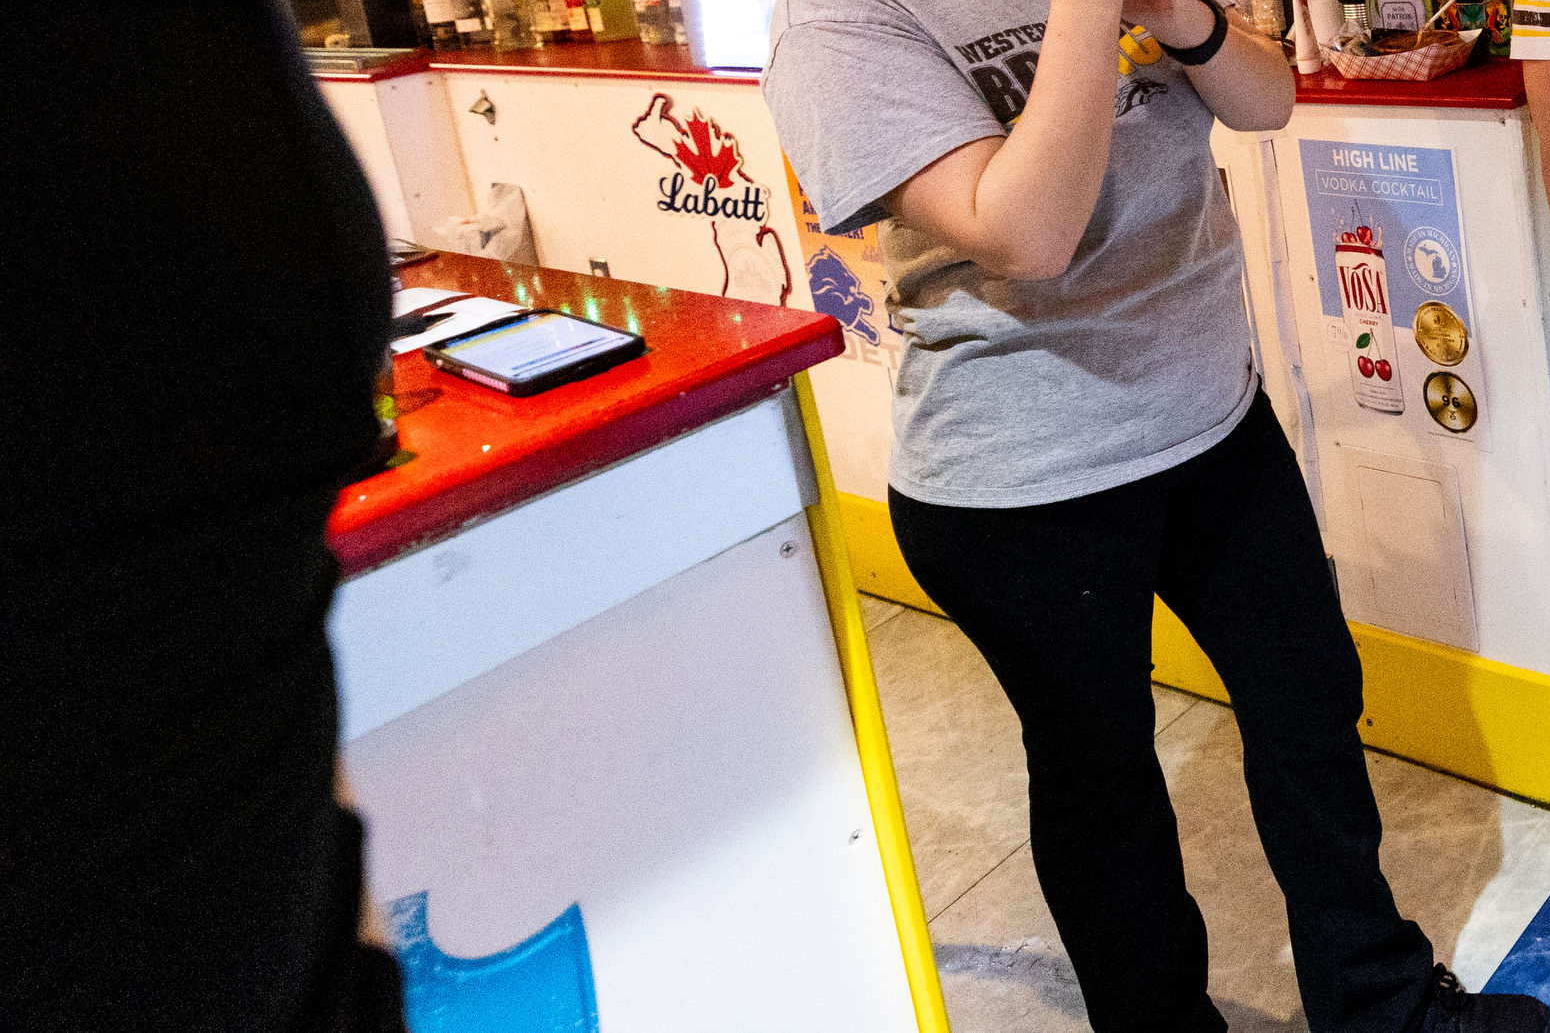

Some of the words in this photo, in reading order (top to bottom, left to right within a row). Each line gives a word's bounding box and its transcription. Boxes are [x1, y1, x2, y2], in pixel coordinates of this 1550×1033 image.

[954, 19, 1049, 64] WESTER
[1332, 148, 1375, 170] HIGH
[1379, 152, 1419, 173] LINE
[657, 172, 767, 222] Labatt
[1320, 175, 1368, 194] VODKA
[1372, 180, 1438, 201] COCKTAIL
[1441, 394, 1462, 410] 96
